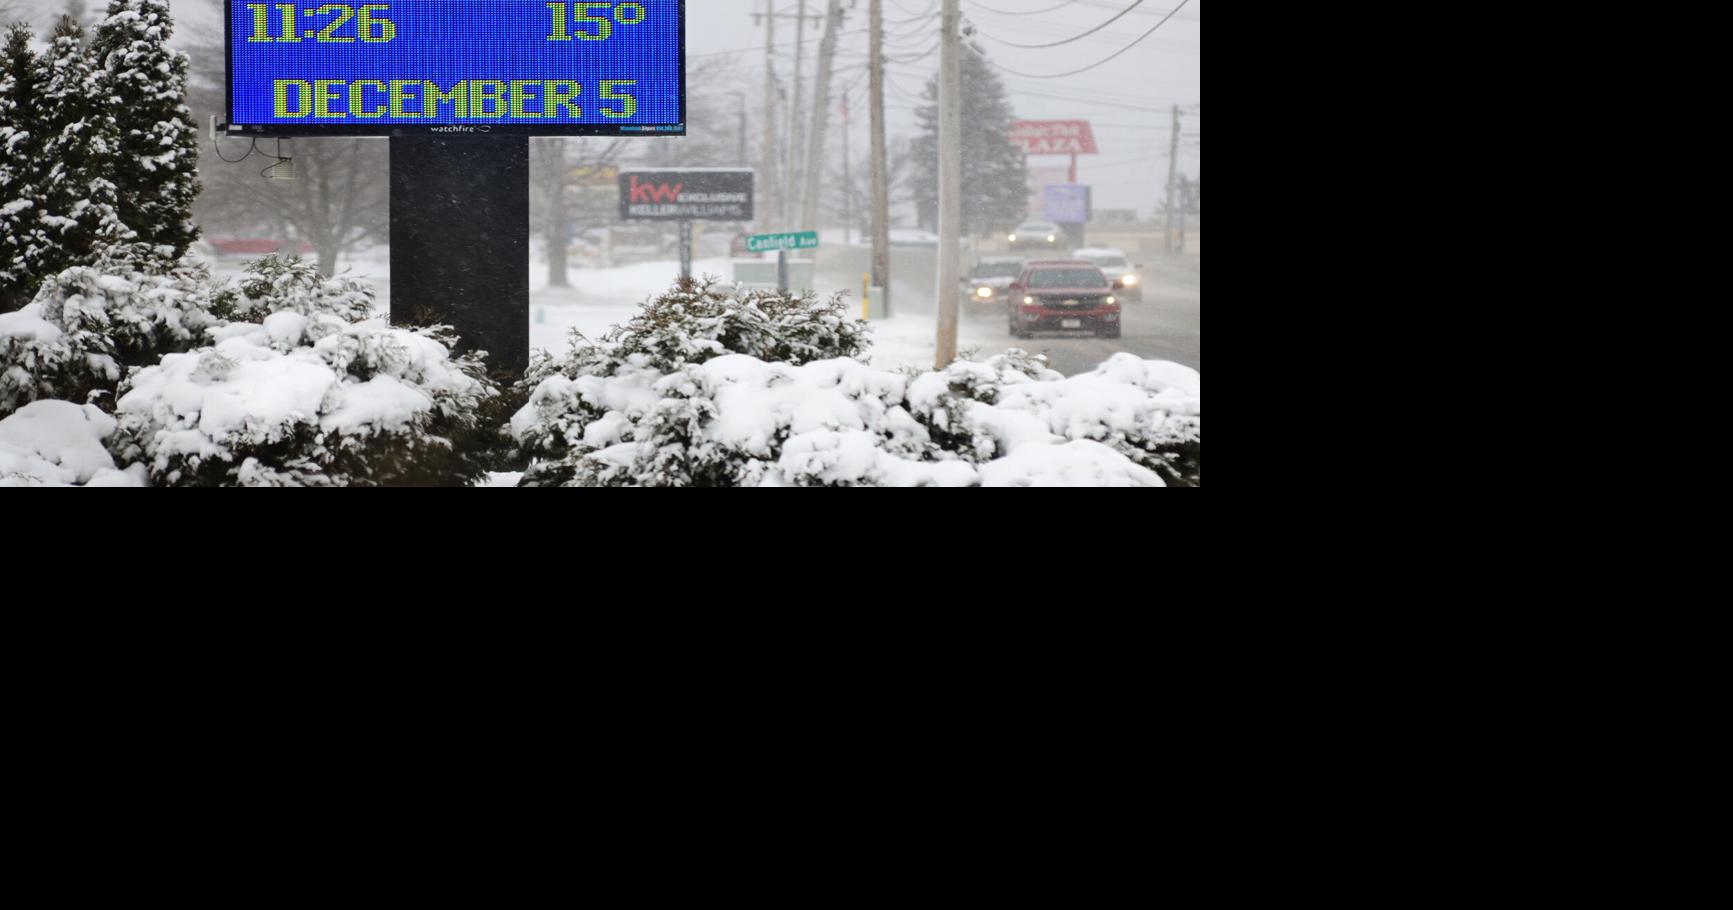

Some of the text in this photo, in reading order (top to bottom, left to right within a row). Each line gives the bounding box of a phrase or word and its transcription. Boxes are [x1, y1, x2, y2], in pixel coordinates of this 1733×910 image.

[246, 2, 396, 42] 11:26
[273, 79, 637, 119] DECEMBER 5
[430, 124, 475, 133] watchfire
[628, 175, 747, 204] kw EXCLUSIVE
[747, 234, 817, 251] Canfield Ave
